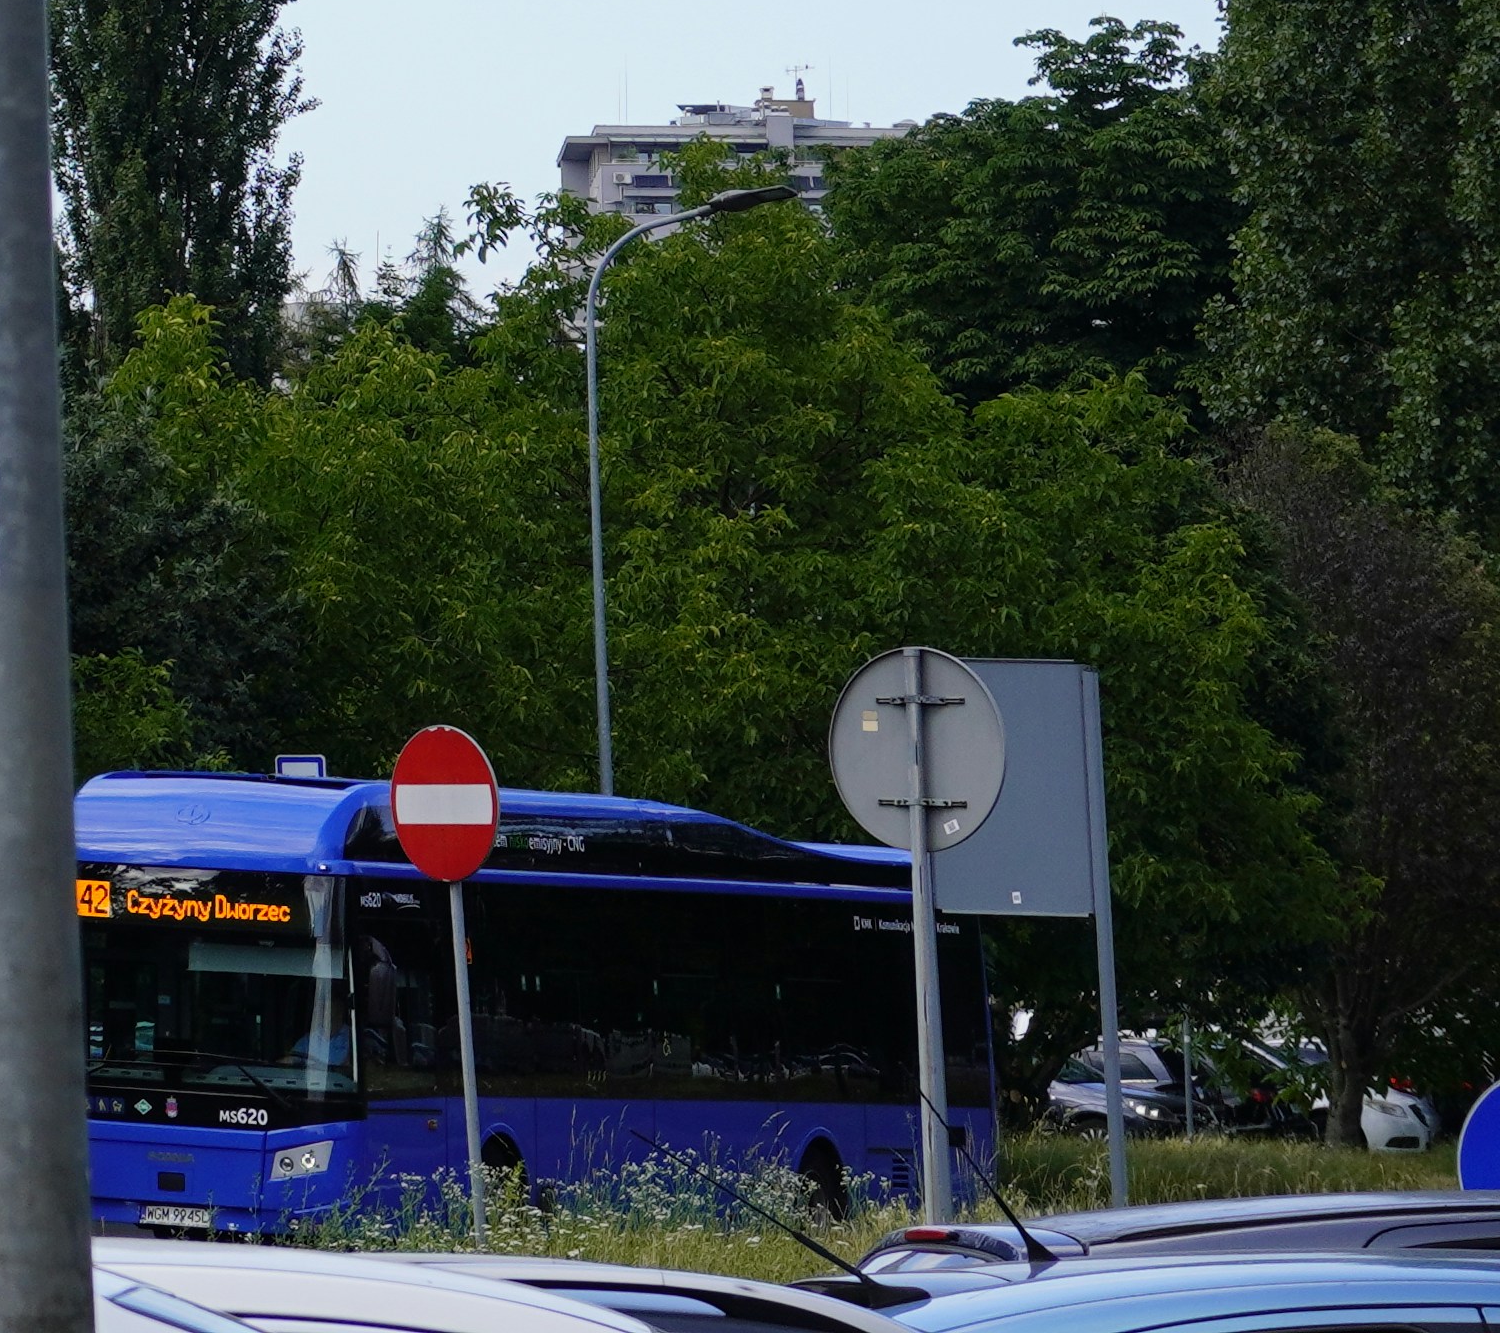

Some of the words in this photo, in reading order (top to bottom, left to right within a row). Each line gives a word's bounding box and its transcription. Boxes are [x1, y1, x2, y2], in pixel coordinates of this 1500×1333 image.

[567, 835, 585, 852] CNG
[127, 889, 211, 922] Czyżyny
[214, 894, 292, 922] Dworzec
[219, 1108, 268, 1126] MS620
[147, 1206, 170, 1221] WGM
